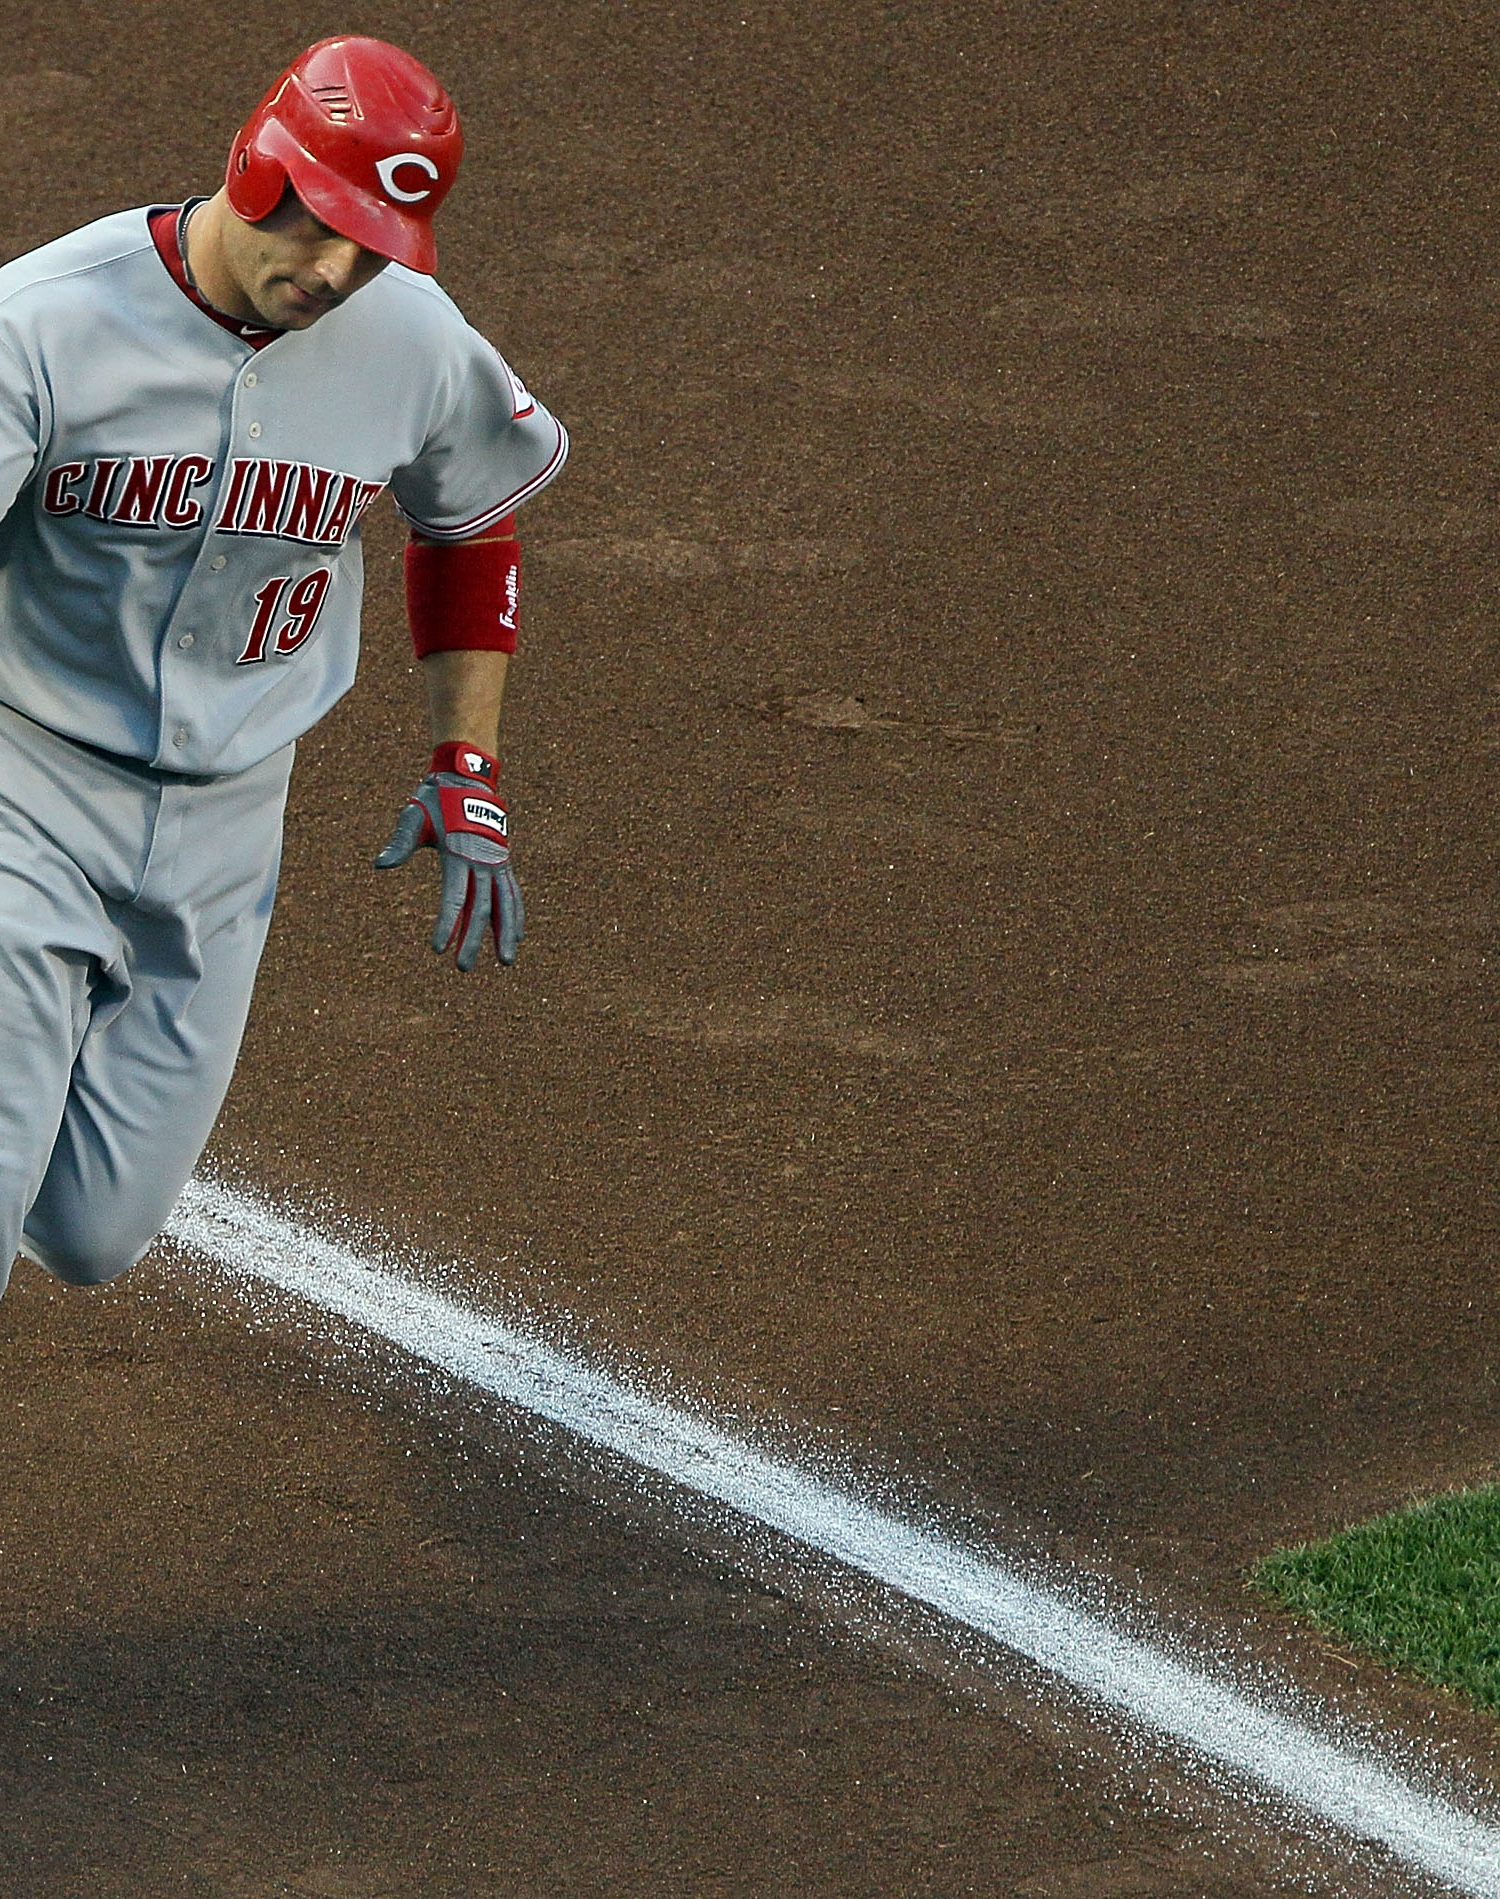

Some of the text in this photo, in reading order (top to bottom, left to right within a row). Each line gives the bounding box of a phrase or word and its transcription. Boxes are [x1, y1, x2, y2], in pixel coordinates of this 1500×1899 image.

[375, 152, 439, 204] C
[43, 453, 388, 547] CINCINNAT
[236, 566, 333, 665] 19
